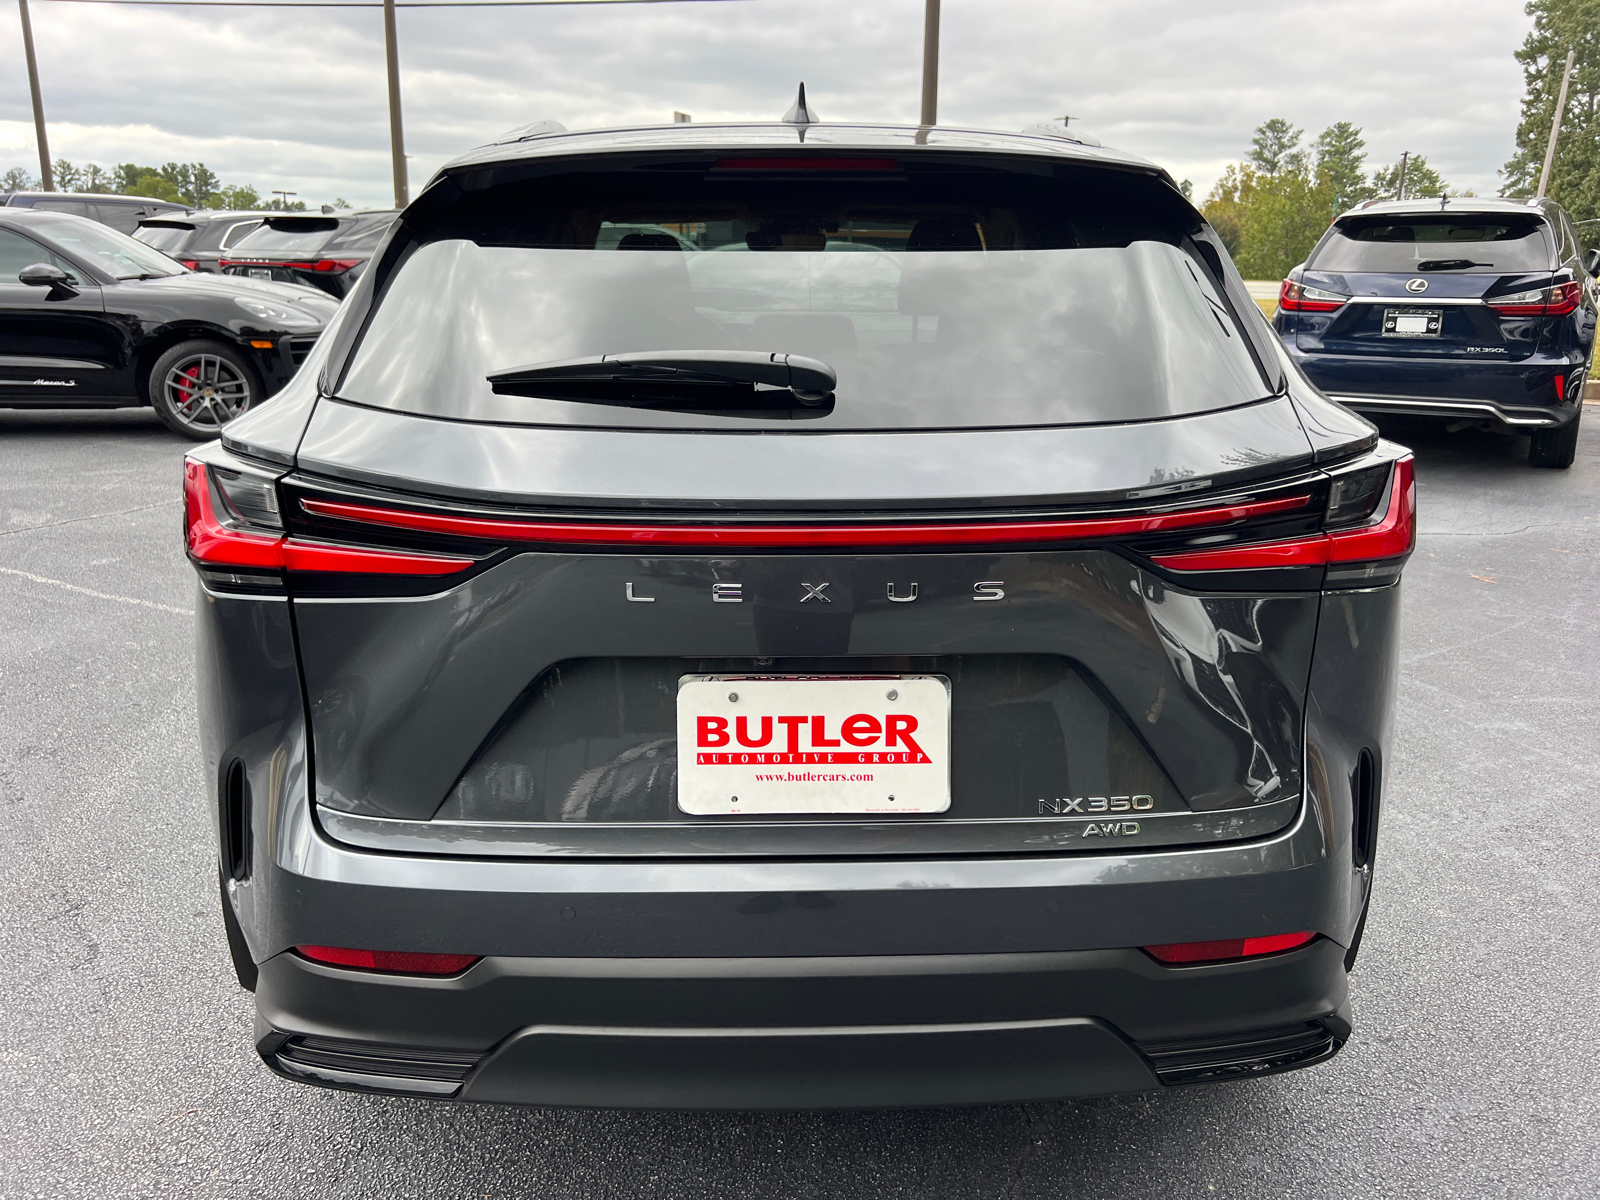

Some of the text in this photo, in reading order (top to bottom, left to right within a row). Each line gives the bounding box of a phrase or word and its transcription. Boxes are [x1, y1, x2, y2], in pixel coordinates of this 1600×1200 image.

[625, 581, 1005, 602] LEXUS
[698, 752, 923, 764] AUTOMOTIVE GROUP
[755, 772, 874, 782] www.butlercars.com
[1038, 795, 1154, 814] NX350
[1082, 822, 1141, 838] AWD
